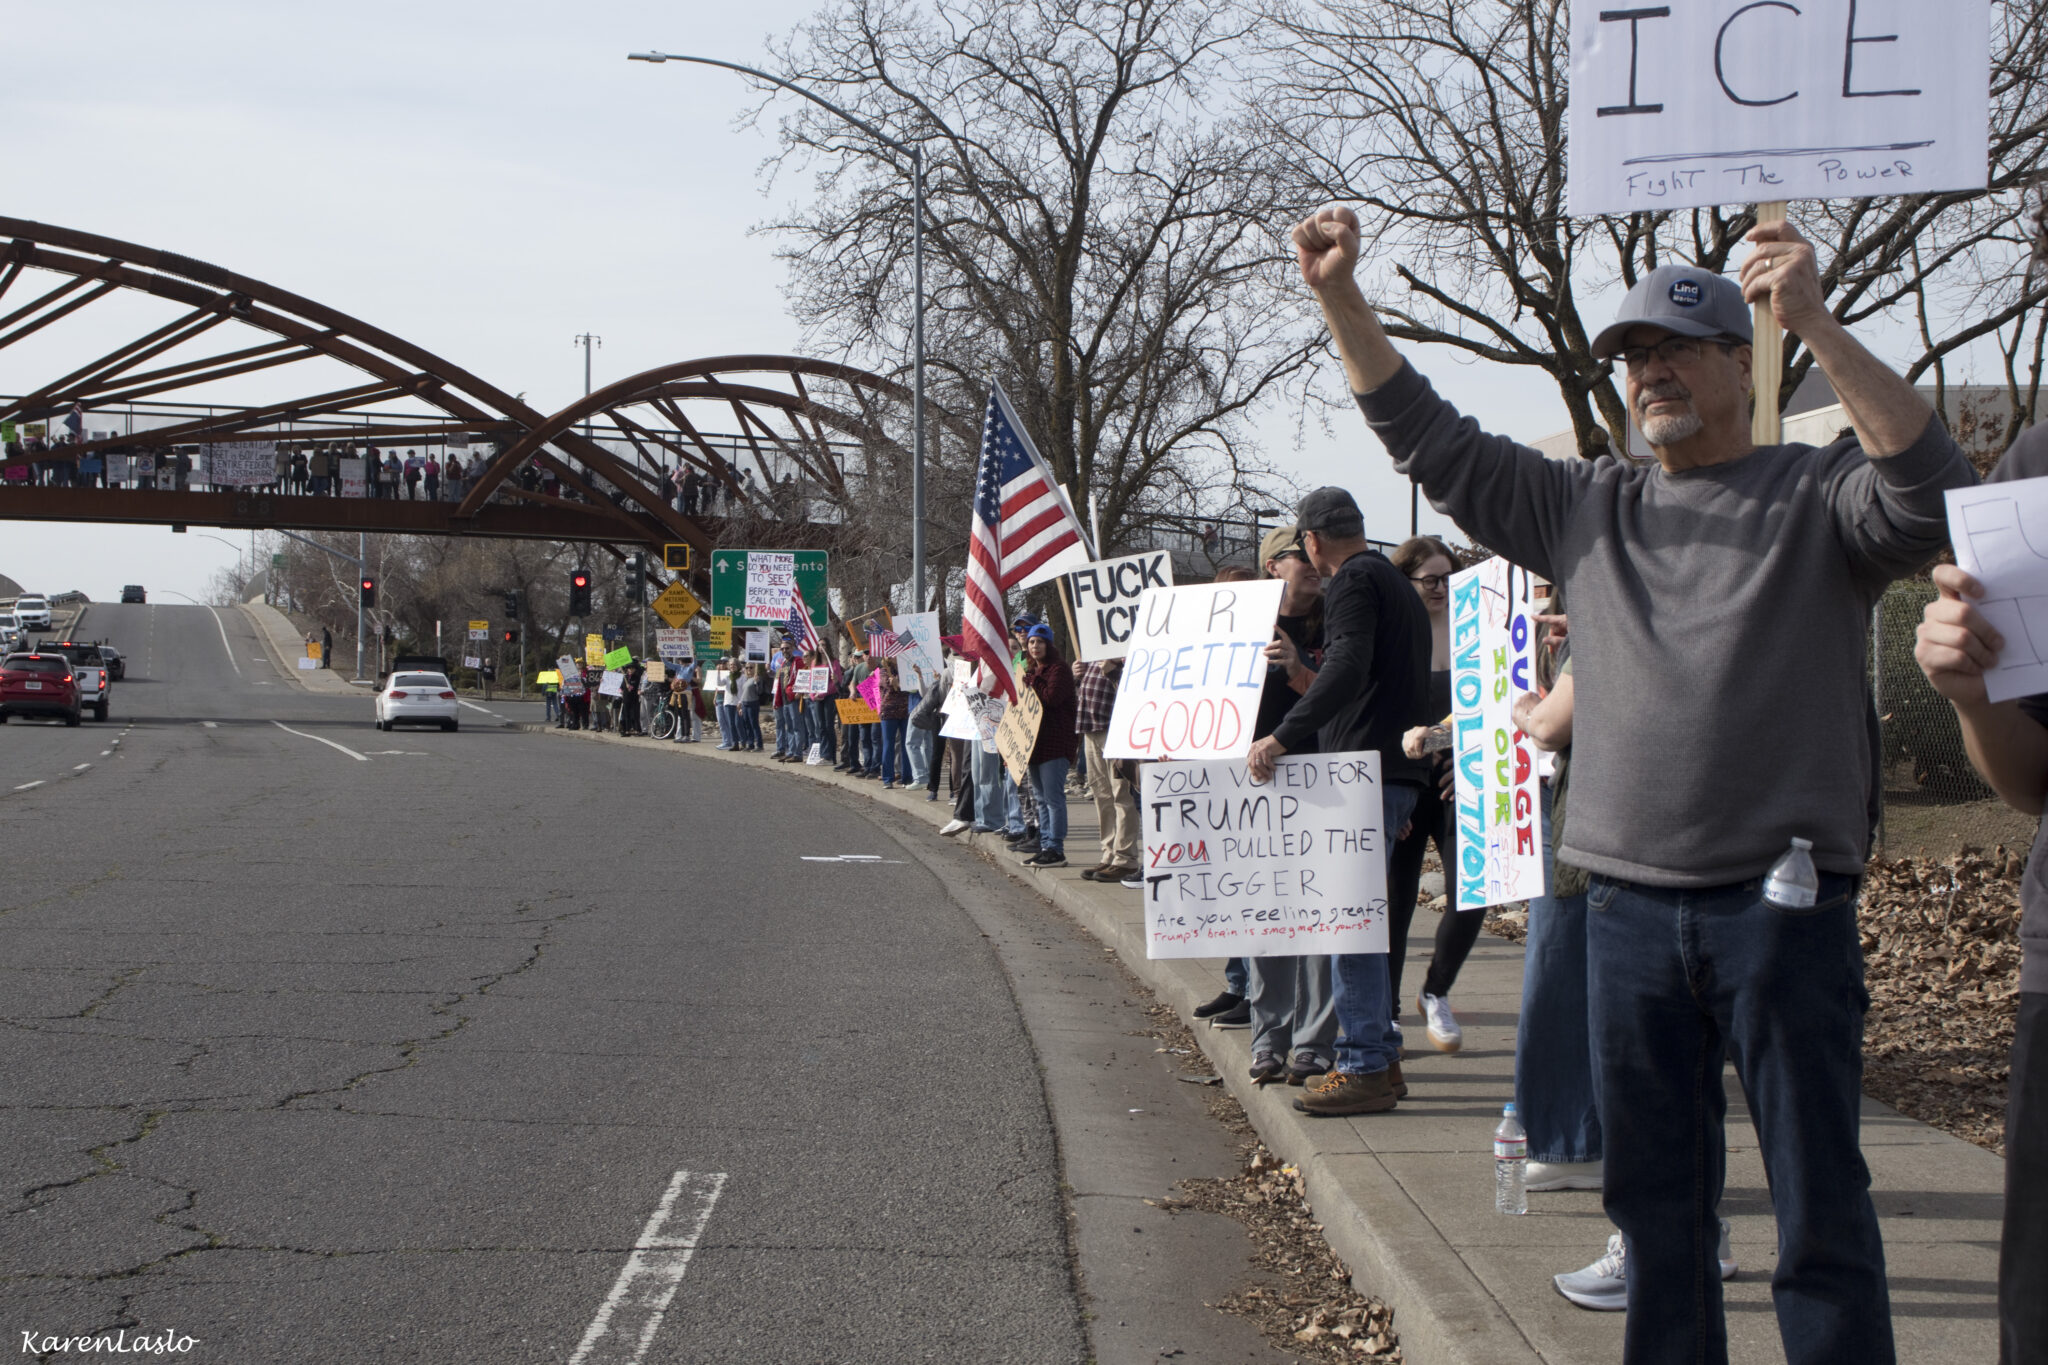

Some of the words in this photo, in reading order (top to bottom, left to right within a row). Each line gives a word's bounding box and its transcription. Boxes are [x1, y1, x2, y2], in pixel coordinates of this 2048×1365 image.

[1597, 0, 1922, 117] ICE
[1674, 283, 1698, 294] Lind
[748, 563, 758, 571] DO
[760, 564, 772, 573] YOU
[773, 563, 794, 572] NEED
[749, 554, 773, 563] WHAT
[775, 555, 793, 564] MORE
[748, 586, 774, 596] BEFORE
[778, 588, 791, 597] YOU
[751, 573, 764, 583] TO
[768, 573, 792, 586] SEE?
[1072, 554, 1168, 608] FUCK
[747, 605, 790, 620] TYRANNY
[750, 596, 767, 605] CALL
[769, 596, 787, 606] OUT
[1146, 593, 1176, 637] U
[1207, 589, 1237, 633] R
[1124, 641, 1267, 692] PRETTI
[1493, 644, 1508, 704] IS
[1129, 697, 1242, 754] GOOD
[1504, 561, 1535, 856] COUAGE
[1453, 573, 1487, 906] REVOLUTION
[1153, 768, 1210, 795] YOU
[1328, 761, 1374, 786] FOR
[1494, 727, 1511, 827] OUR
[1151, 795, 1299, 832] TRUMP
[1148, 840, 1210, 868] YOU
[1222, 830, 1313, 862] PULLED
[1325, 828, 1377, 853] THE
[1146, 869, 1324, 902] TRIGGER
[1153, 928, 1199, 943] Trump's
[1208, 925, 1238, 939] brain
[1245, 926, 1255, 936] is
[1333, 919, 1372, 935] yours?
[1157, 913, 1187, 929] Are
[1197, 911, 1232, 930] you
[1329, 898, 1389, 929] great?
